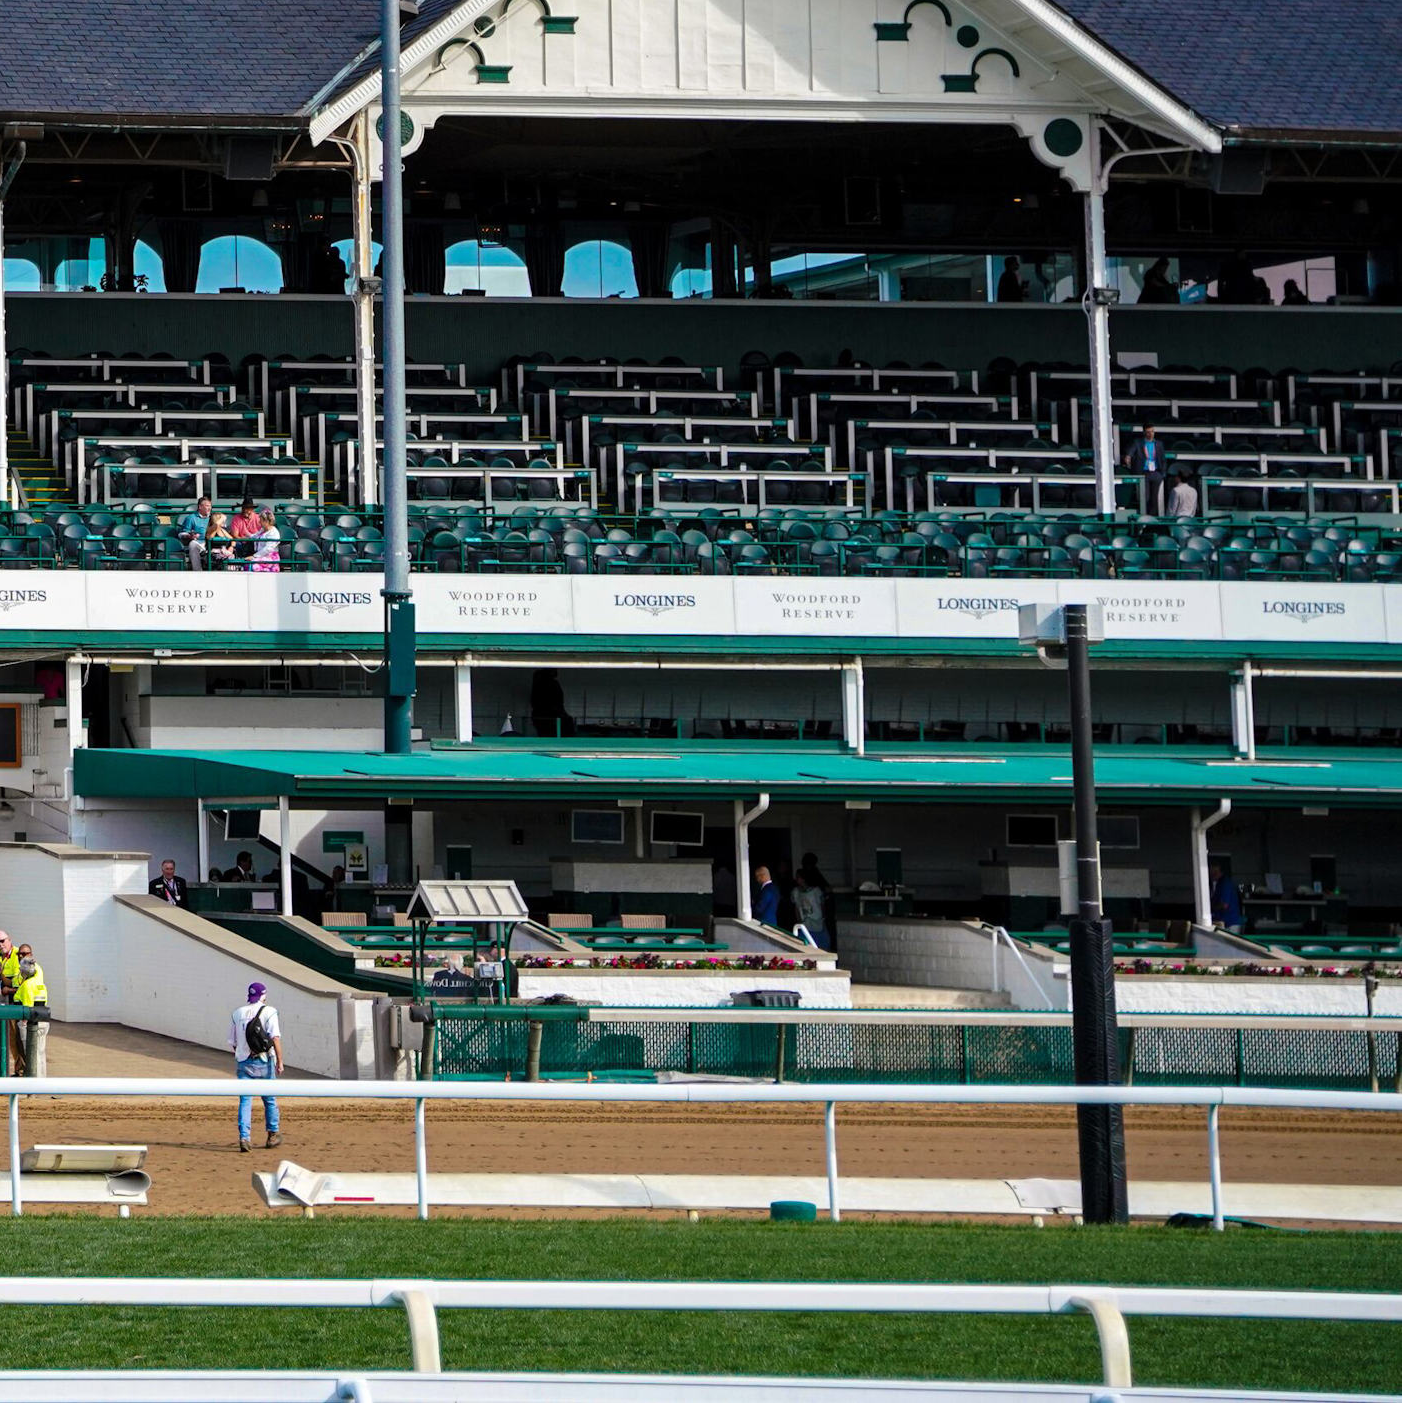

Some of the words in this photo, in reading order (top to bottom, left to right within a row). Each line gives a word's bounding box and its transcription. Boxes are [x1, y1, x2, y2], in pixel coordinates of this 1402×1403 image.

[125, 588, 214, 599] WOODFORD
[289, 591, 372, 605] LONGINES
[449, 590, 538, 601] WOODFORD
[772, 593, 861, 604] WOODFORD
[613, 594, 696, 607] LONGINES
[937, 597, 1019, 611] LONGINES
[135, 603, 207, 613] RESERVE
[458, 606, 530, 616] RESERVE
[1262, 601, 1346, 614] LONGINES
[782, 608, 854, 619] RESERVE
[1107, 612, 1178, 622] RESERVE
